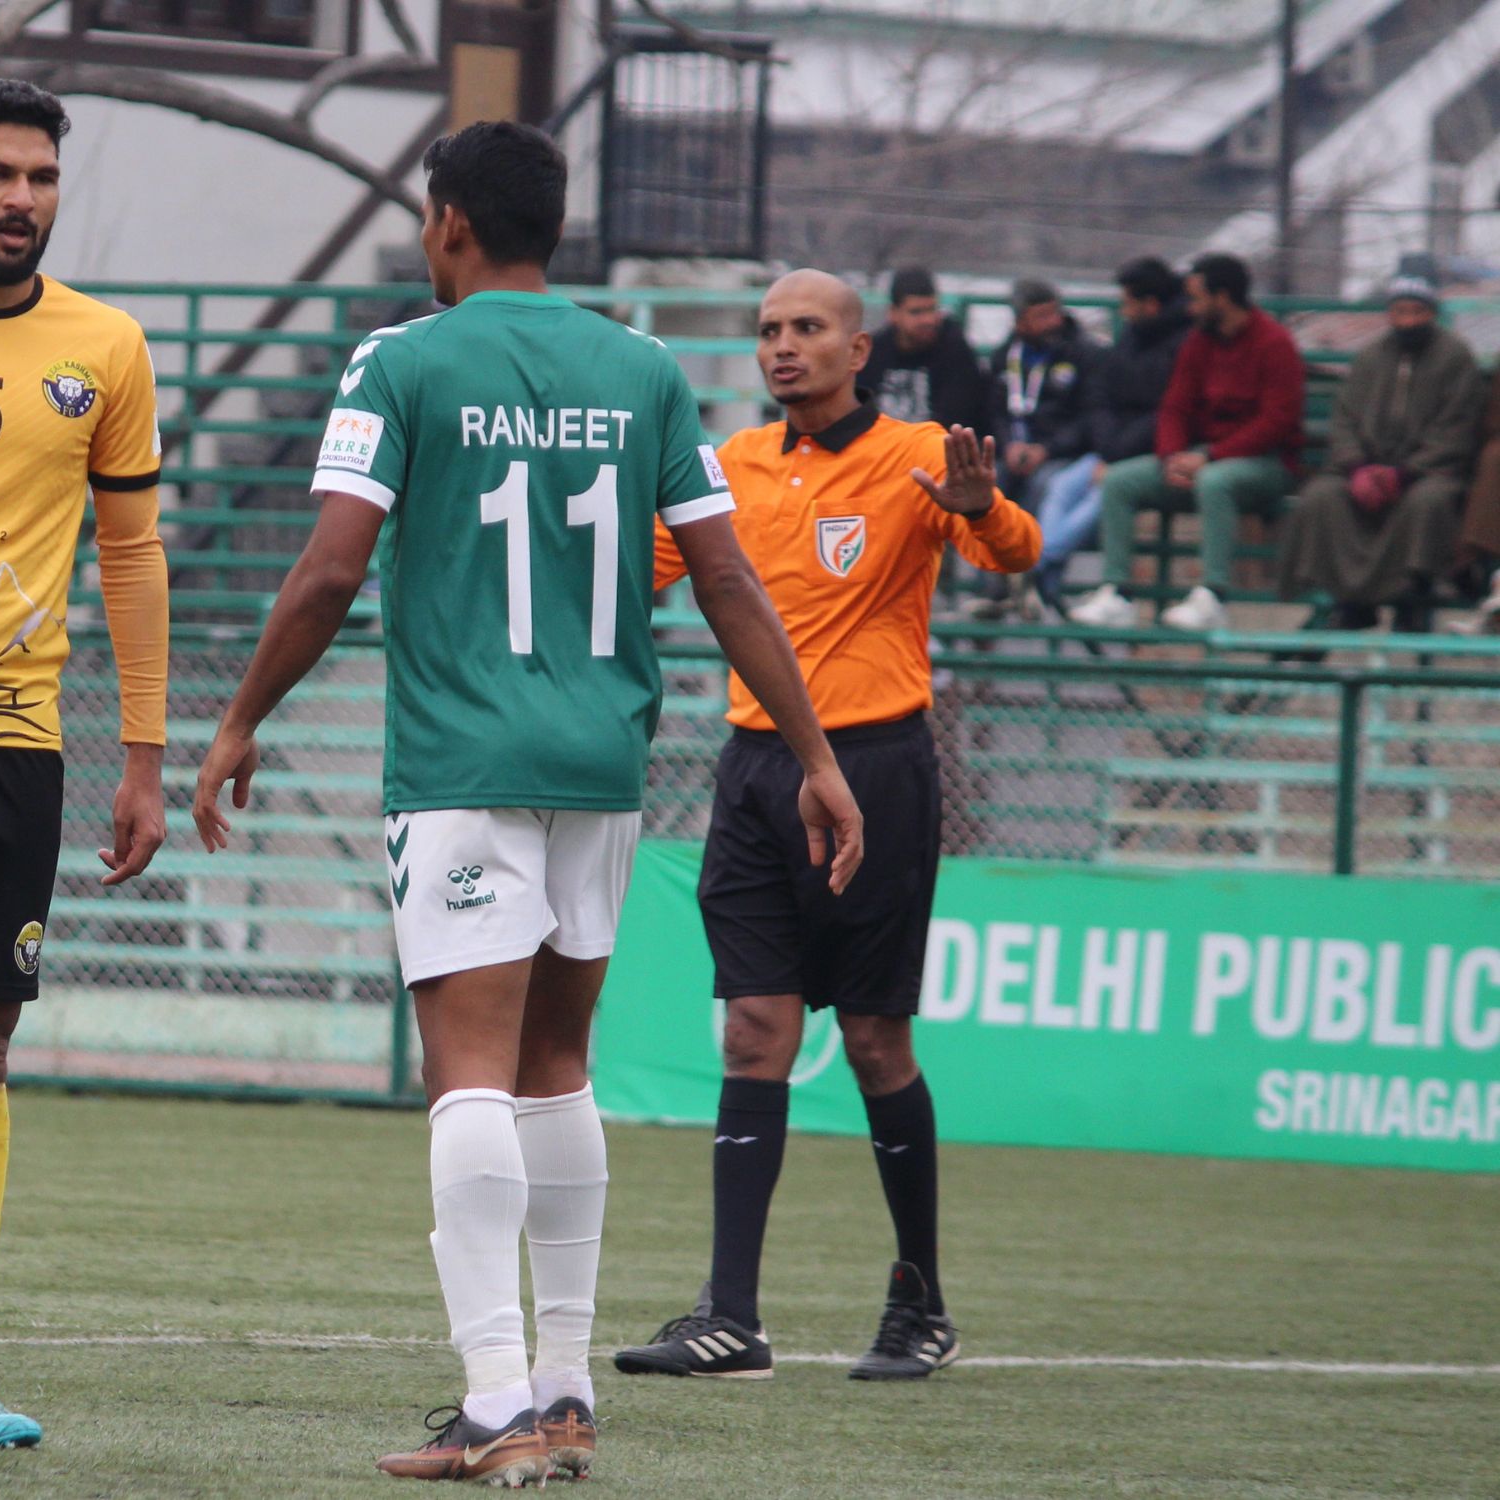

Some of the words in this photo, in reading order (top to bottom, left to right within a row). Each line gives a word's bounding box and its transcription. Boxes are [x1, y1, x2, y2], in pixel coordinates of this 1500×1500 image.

[460, 404, 633, 451] RANJEET
[479, 460, 619, 657] 11
[446, 889, 497, 912] hummel
[918, 916, 1169, 1033] DELHI
[1191, 930, 1500, 1053] PUBLIC
